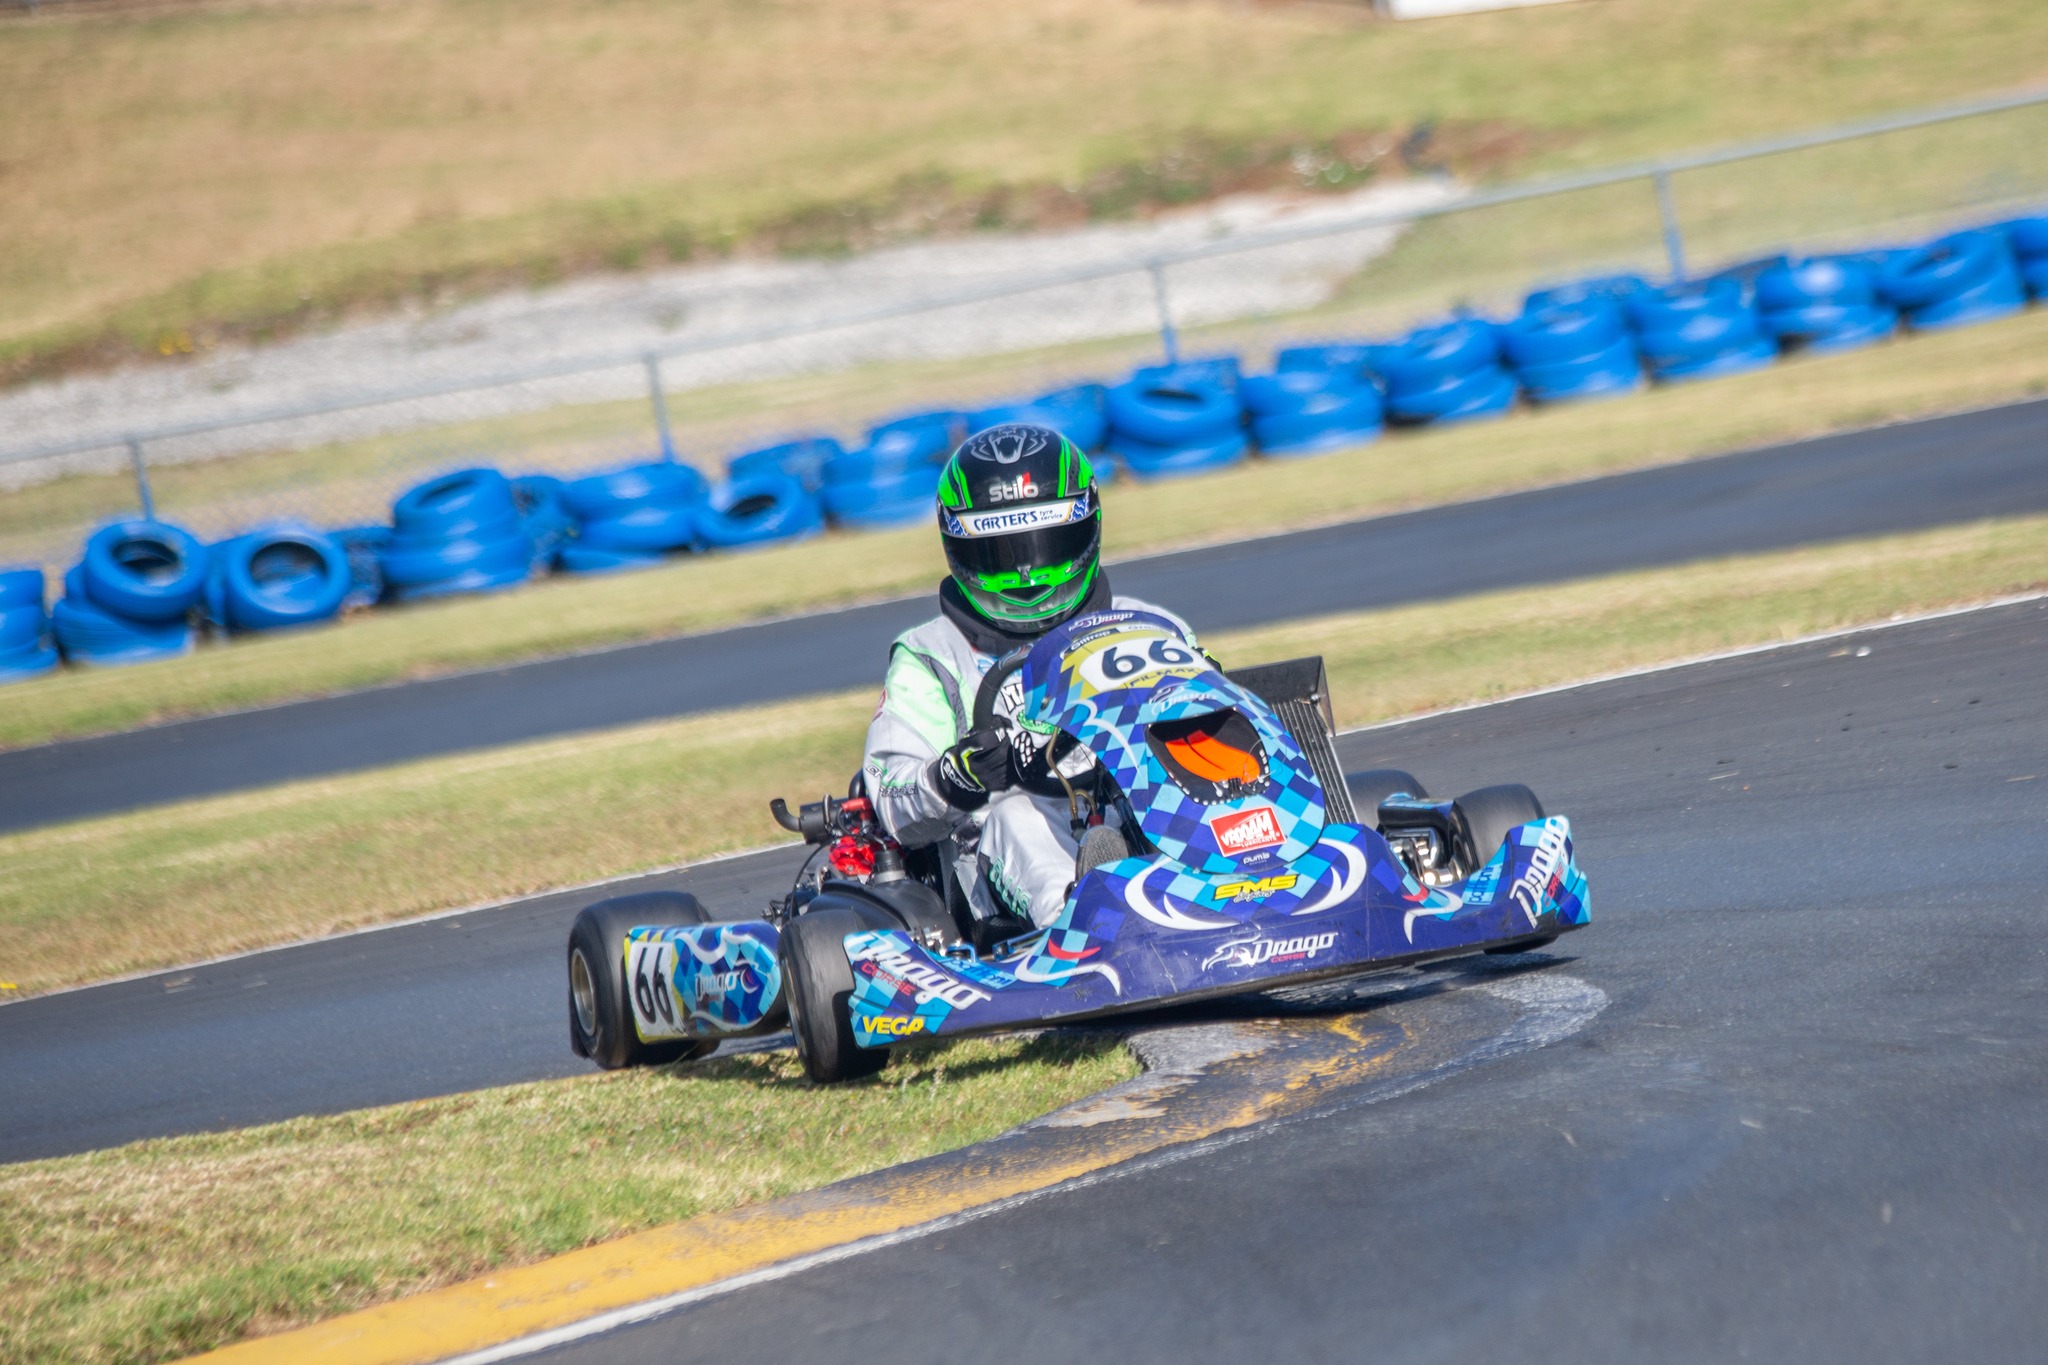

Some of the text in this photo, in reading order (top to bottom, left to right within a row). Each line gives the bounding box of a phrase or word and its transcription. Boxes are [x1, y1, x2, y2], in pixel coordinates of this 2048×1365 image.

[989, 472, 1039, 502] stilo
[974, 510, 1038, 532] CARTER'S
[1039, 509, 1053, 517] tyre
[1101, 639, 1194, 680] 66
[1213, 874, 1298, 900] SMS
[1508, 814, 1570, 929] Drago
[1251, 931, 1339, 963] Drago
[1271, 951, 1306, 963] CORSE
[635, 947, 674, 1024] 66
[843, 931, 992, 1011] Drago
[860, 962, 917, 997] CORSE
[862, 1015, 926, 1036] VEGA
